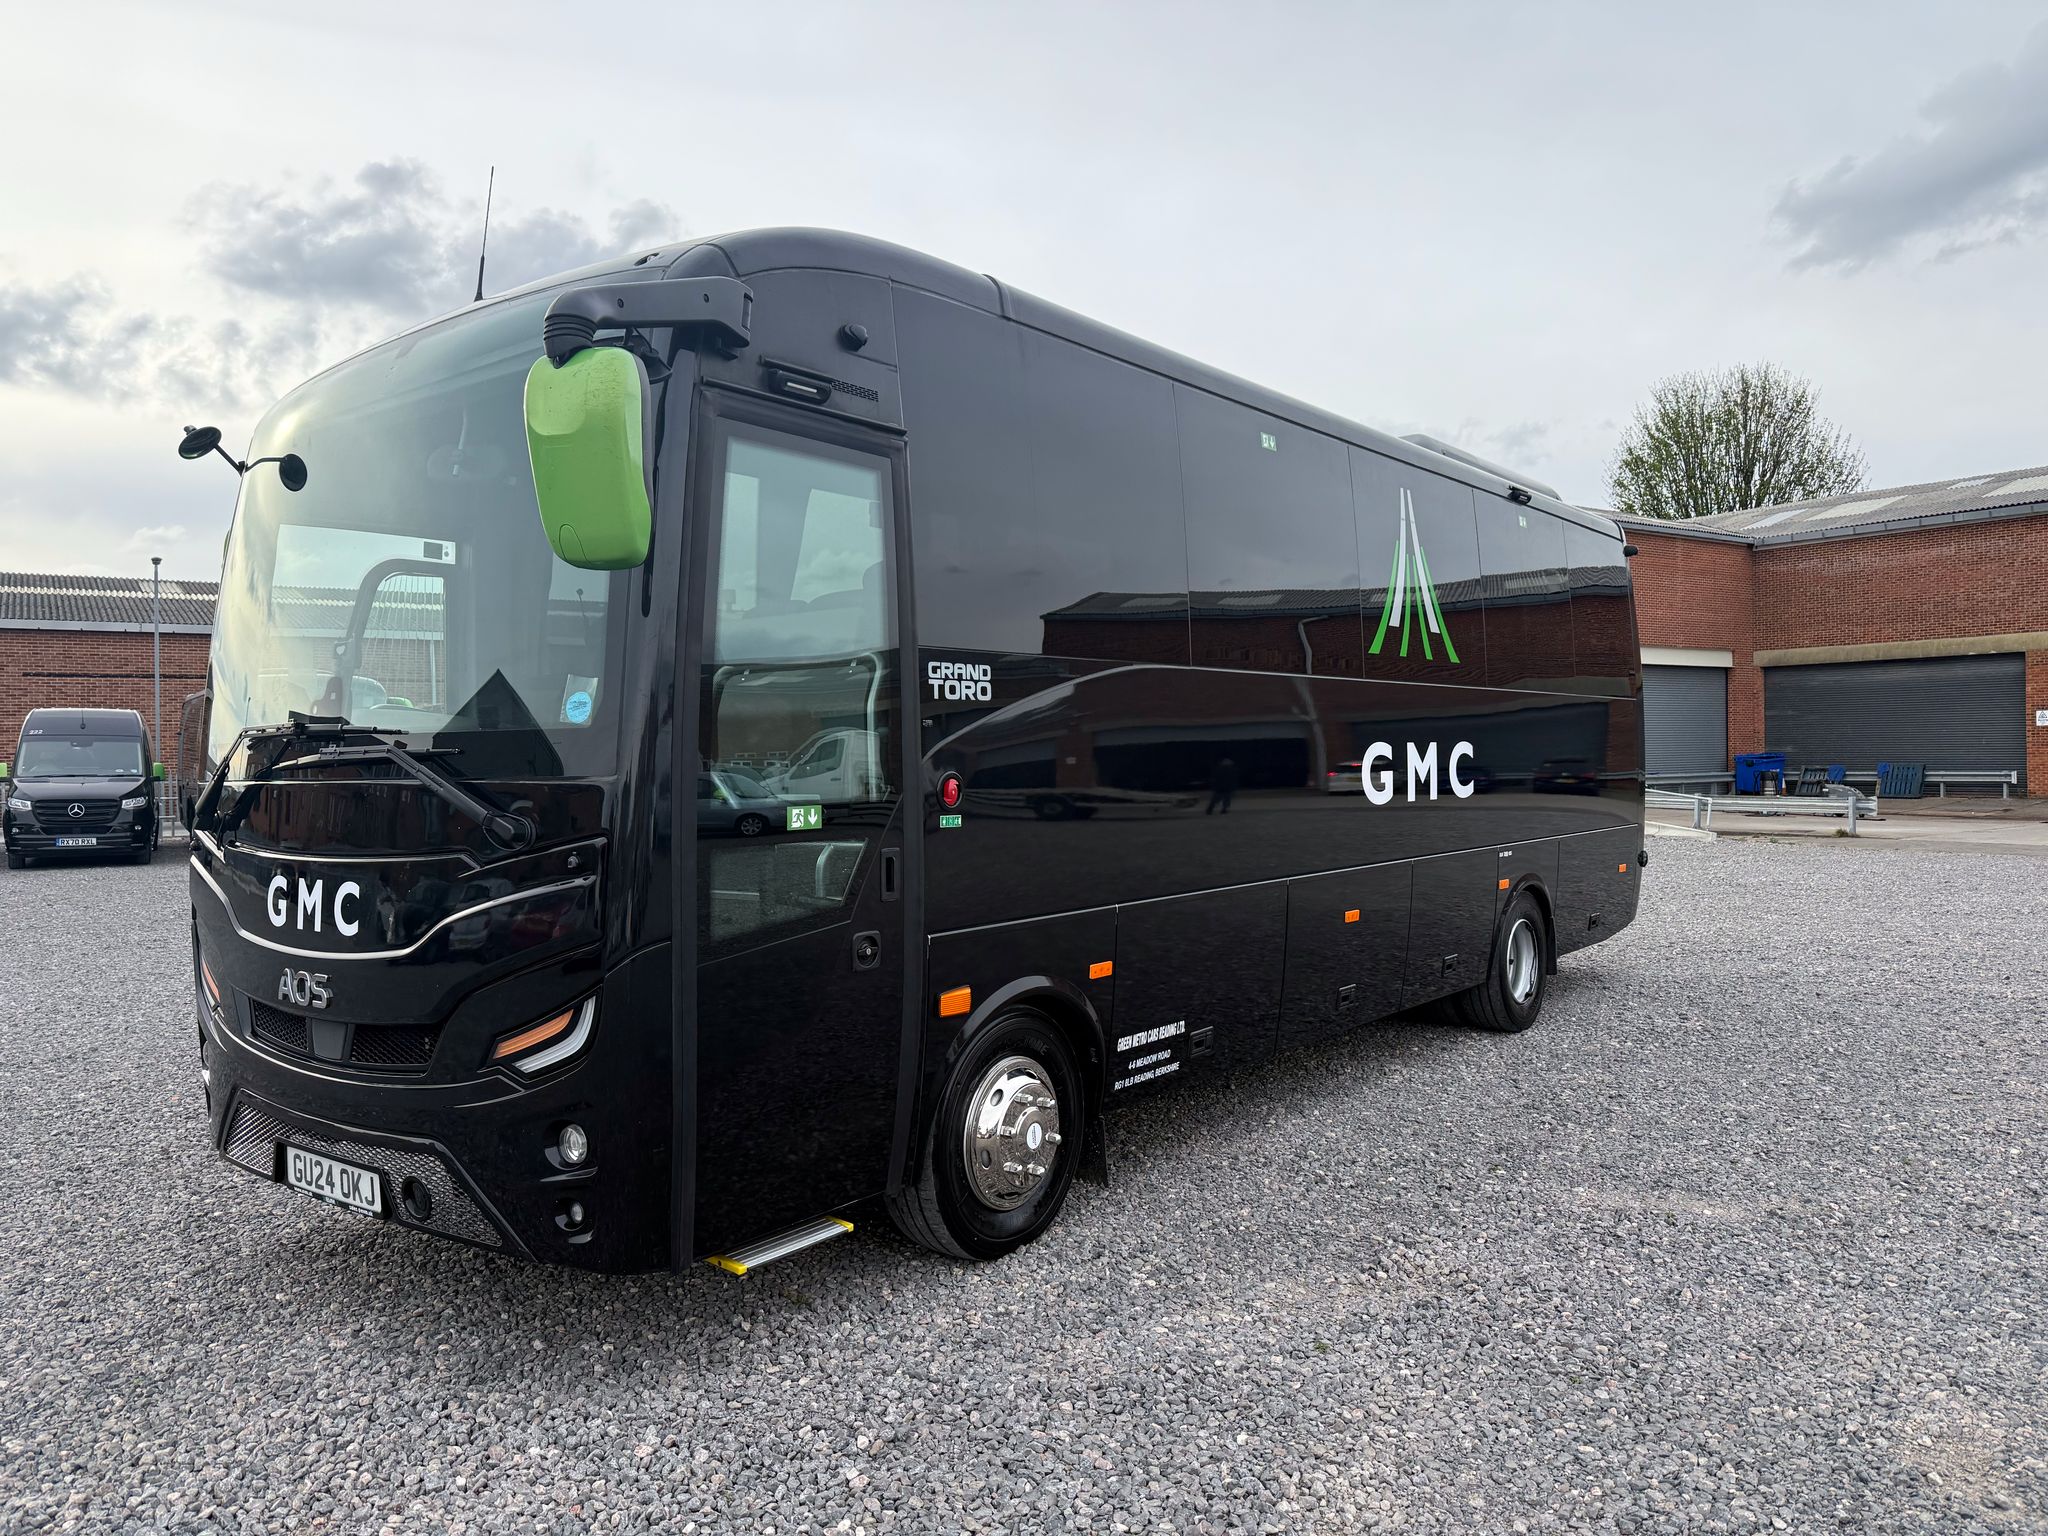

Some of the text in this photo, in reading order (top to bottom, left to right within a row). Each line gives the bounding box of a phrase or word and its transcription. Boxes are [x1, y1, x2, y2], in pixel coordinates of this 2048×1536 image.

[928, 661, 992, 681] GRAND
[928, 679, 992, 701] TORO
[1361, 741, 1475, 806] GMC
[267, 875, 361, 937] GMC
[277, 967, 334, 1010] AOS
[1117, 1035, 1133, 1052] GREEN
[1132, 1030, 1148, 1047] METRO
[1147, 1027, 1159, 1043] CARS
[1159, 1022, 1177, 1040] READING
[1136, 1053, 1157, 1068] MEADOW
[1157, 1049, 1172, 1061] ROAD
[1114, 1079, 1125, 1091] RG1
[1155, 1061, 1180, 1077] BERKSHIRE
[293, 1152, 376, 1207] GU24 OKJ
